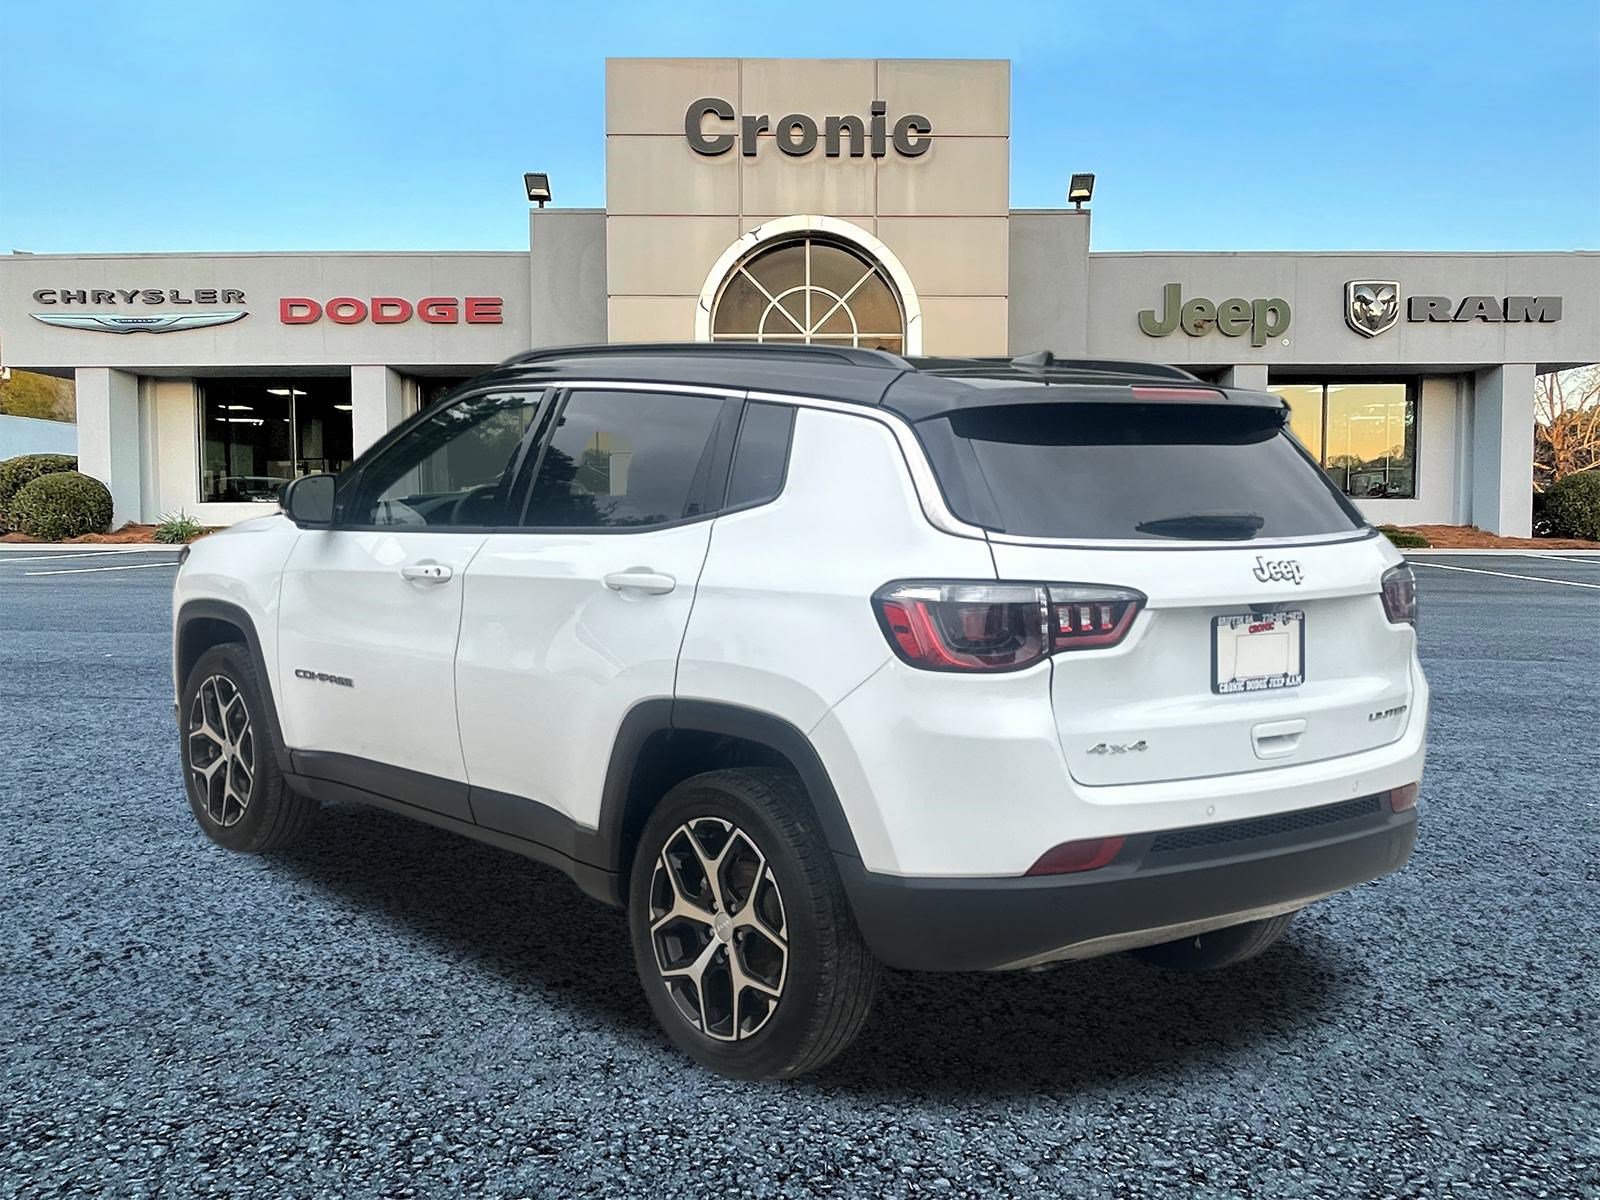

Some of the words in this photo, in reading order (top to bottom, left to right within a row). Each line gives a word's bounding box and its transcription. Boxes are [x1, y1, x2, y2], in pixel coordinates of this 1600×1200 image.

[685, 97, 932, 158] Cronic
[32, 288, 248, 305] CHRYSLER
[280, 296, 504, 325] DODGE
[1408, 296, 1563, 323] RAM
[1138, 282, 1291, 347] Jeep
[1253, 556, 1303, 585] Jeep
[295, 669, 354, 688] COMPASS
[1268, 676, 1284, 689] JEEP
